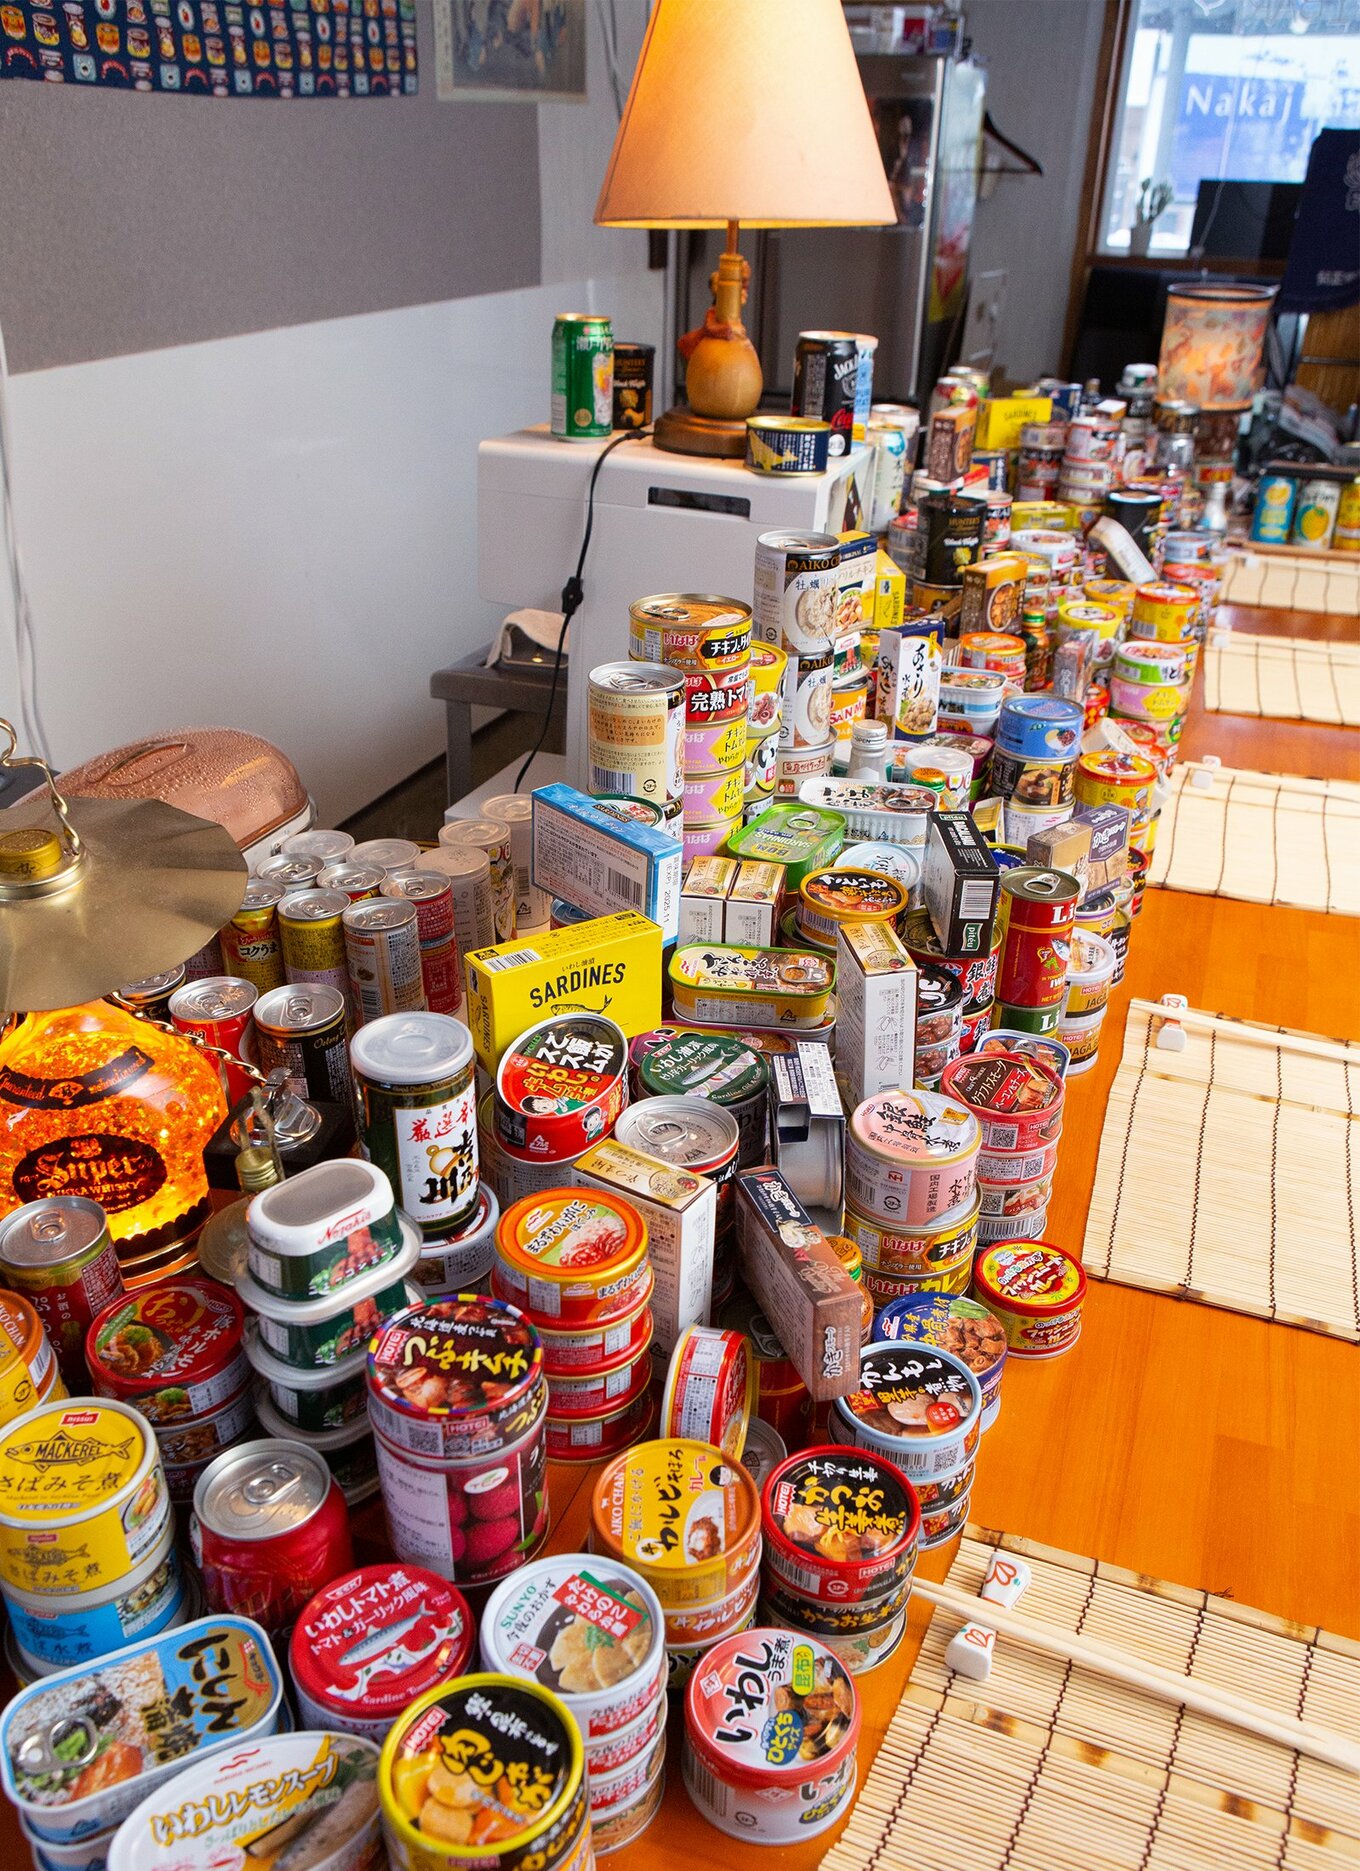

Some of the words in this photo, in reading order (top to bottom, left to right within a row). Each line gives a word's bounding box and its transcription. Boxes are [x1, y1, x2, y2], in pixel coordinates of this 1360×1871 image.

[799, 558, 830, 570] AIKO
[664, 634, 698, 646] いなば
[721, 655, 740, 663] イエロー
[912, 641, 926, 699] あさり
[665, 861, 674, 888] (EXP)
[660, 889, 672, 924] 2025.11
[966, 926, 976, 950] pitéu
[562, 957, 596, 972] いわし油漬
[529, 962, 627, 1008] SARDINES
[1082, 985, 1100, 995] HOTEI
[481, 993, 492, 1054] SARDINES
[1062, 1034, 1083, 1043] HOTEI
[650, 1041, 706, 1074] いわし油漬
[971, 1059, 1007, 1105] クラフトスモーク
[877, 1101, 937, 1133] 銀鮭
[1029, 1121, 1048, 1131] HOTEI
[36, 1150, 143, 1193] Super
[89, 1180, 142, 1194] WHISKY
[763, 1179, 801, 1219] かきスモーク
[926, 1174, 941, 1213] 国内工場製造
[525, 1200, 588, 1255] まるずわいがに
[883, 1236, 927, 1252] いなば
[868, 1277, 919, 1296] いなば
[380, 1331, 401, 1363] HOTEI
[403, 1336, 529, 1379] つぶキムチ
[823, 1326, 843, 1380] かきスモーク
[450, 1418, 489, 1434] HOTEI
[613, 1470, 627, 1504] CHAN
[657, 1447, 686, 1552] カルビそぼろ
[775, 1483, 793, 1515] HOTEI
[797, 1475, 886, 1512] かつお
[611, 1503, 625, 1538] AIKO
[861, 1560, 892, 1577] HOTEI
[304, 1569, 411, 1638] いわしトマト煮
[310, 1581, 430, 1656] トマト&ガーリック風味
[500, 1584, 537, 1630] SUNYO
[565, 1594, 631, 1639] やわらか煮
[567, 1579, 628, 1621] たけのこ
[767, 1636, 792, 1683] うま煮
[178, 1632, 248, 1732] にしん
[362, 1690, 406, 1705] Sardine
[715, 1641, 774, 1744] いわし
[406, 1708, 447, 1752] HOTEI
[766, 1712, 794, 1764] ひとくち
[150, 1754, 339, 1847] いわしレモンスープ
